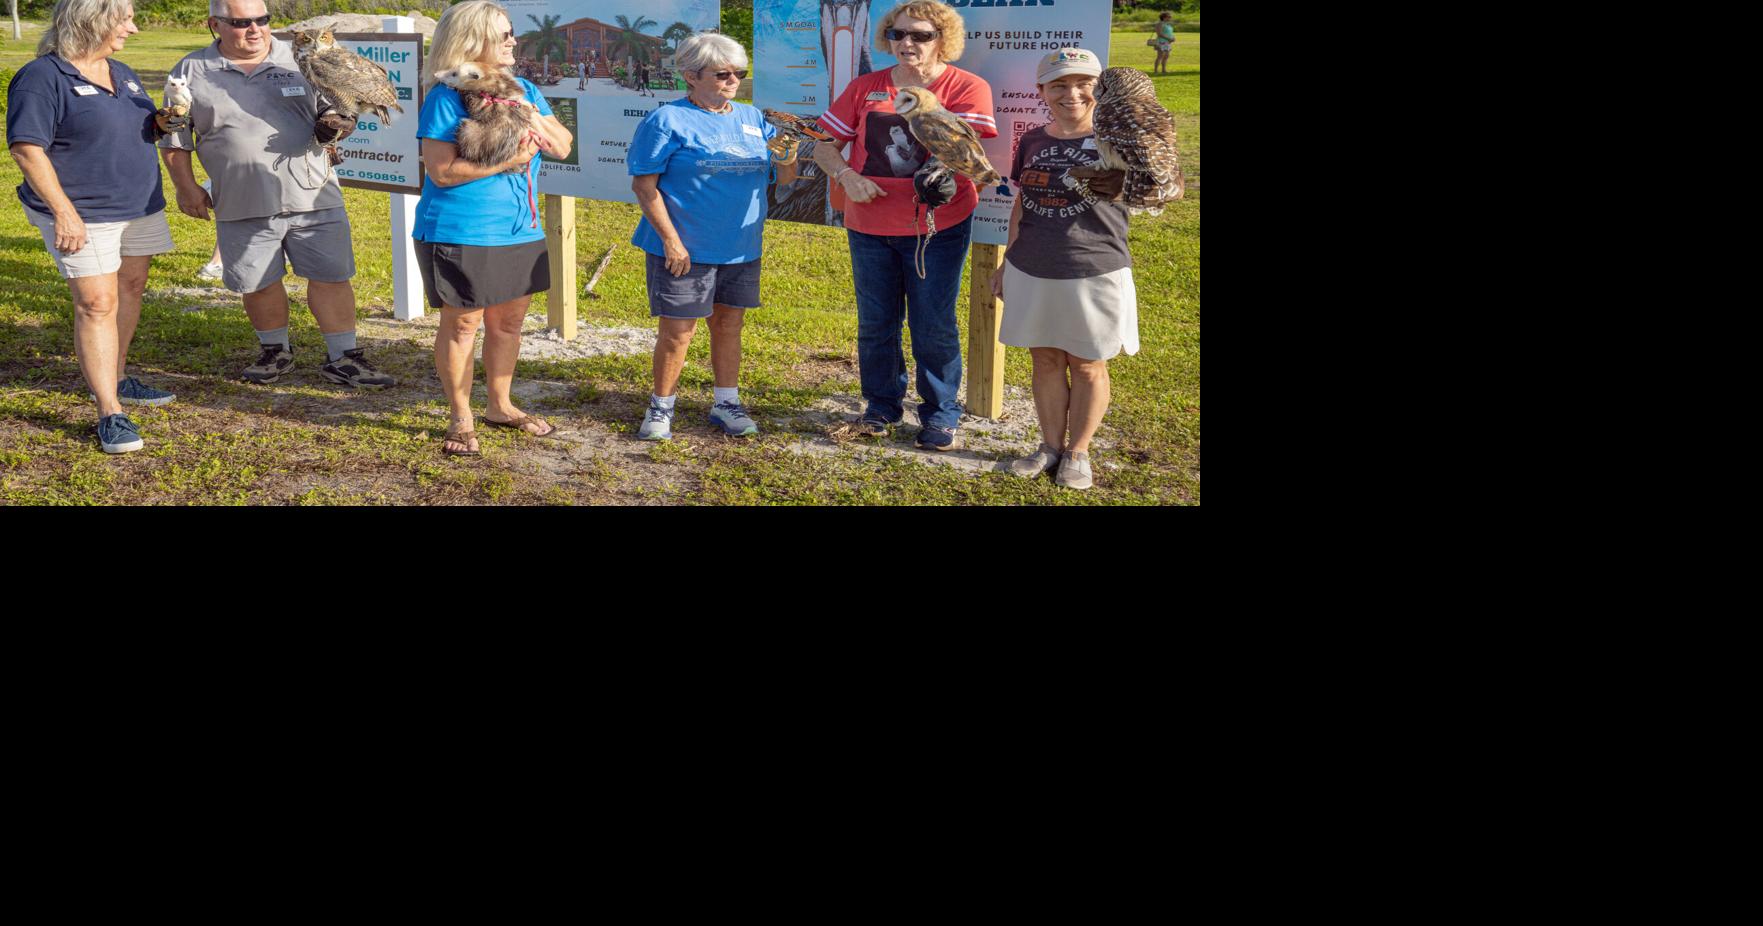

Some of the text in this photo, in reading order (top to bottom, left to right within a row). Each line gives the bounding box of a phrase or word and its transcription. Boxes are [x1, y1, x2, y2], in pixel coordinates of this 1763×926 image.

[965, 31, 1083, 39] LP US BUILD THEIR
[989, 41, 1079, 50] FUTURE HOME
[357, 46, 411, 63] Miller
[335, 147, 404, 162] Contractor
[358, 170, 406, 183] 050895
